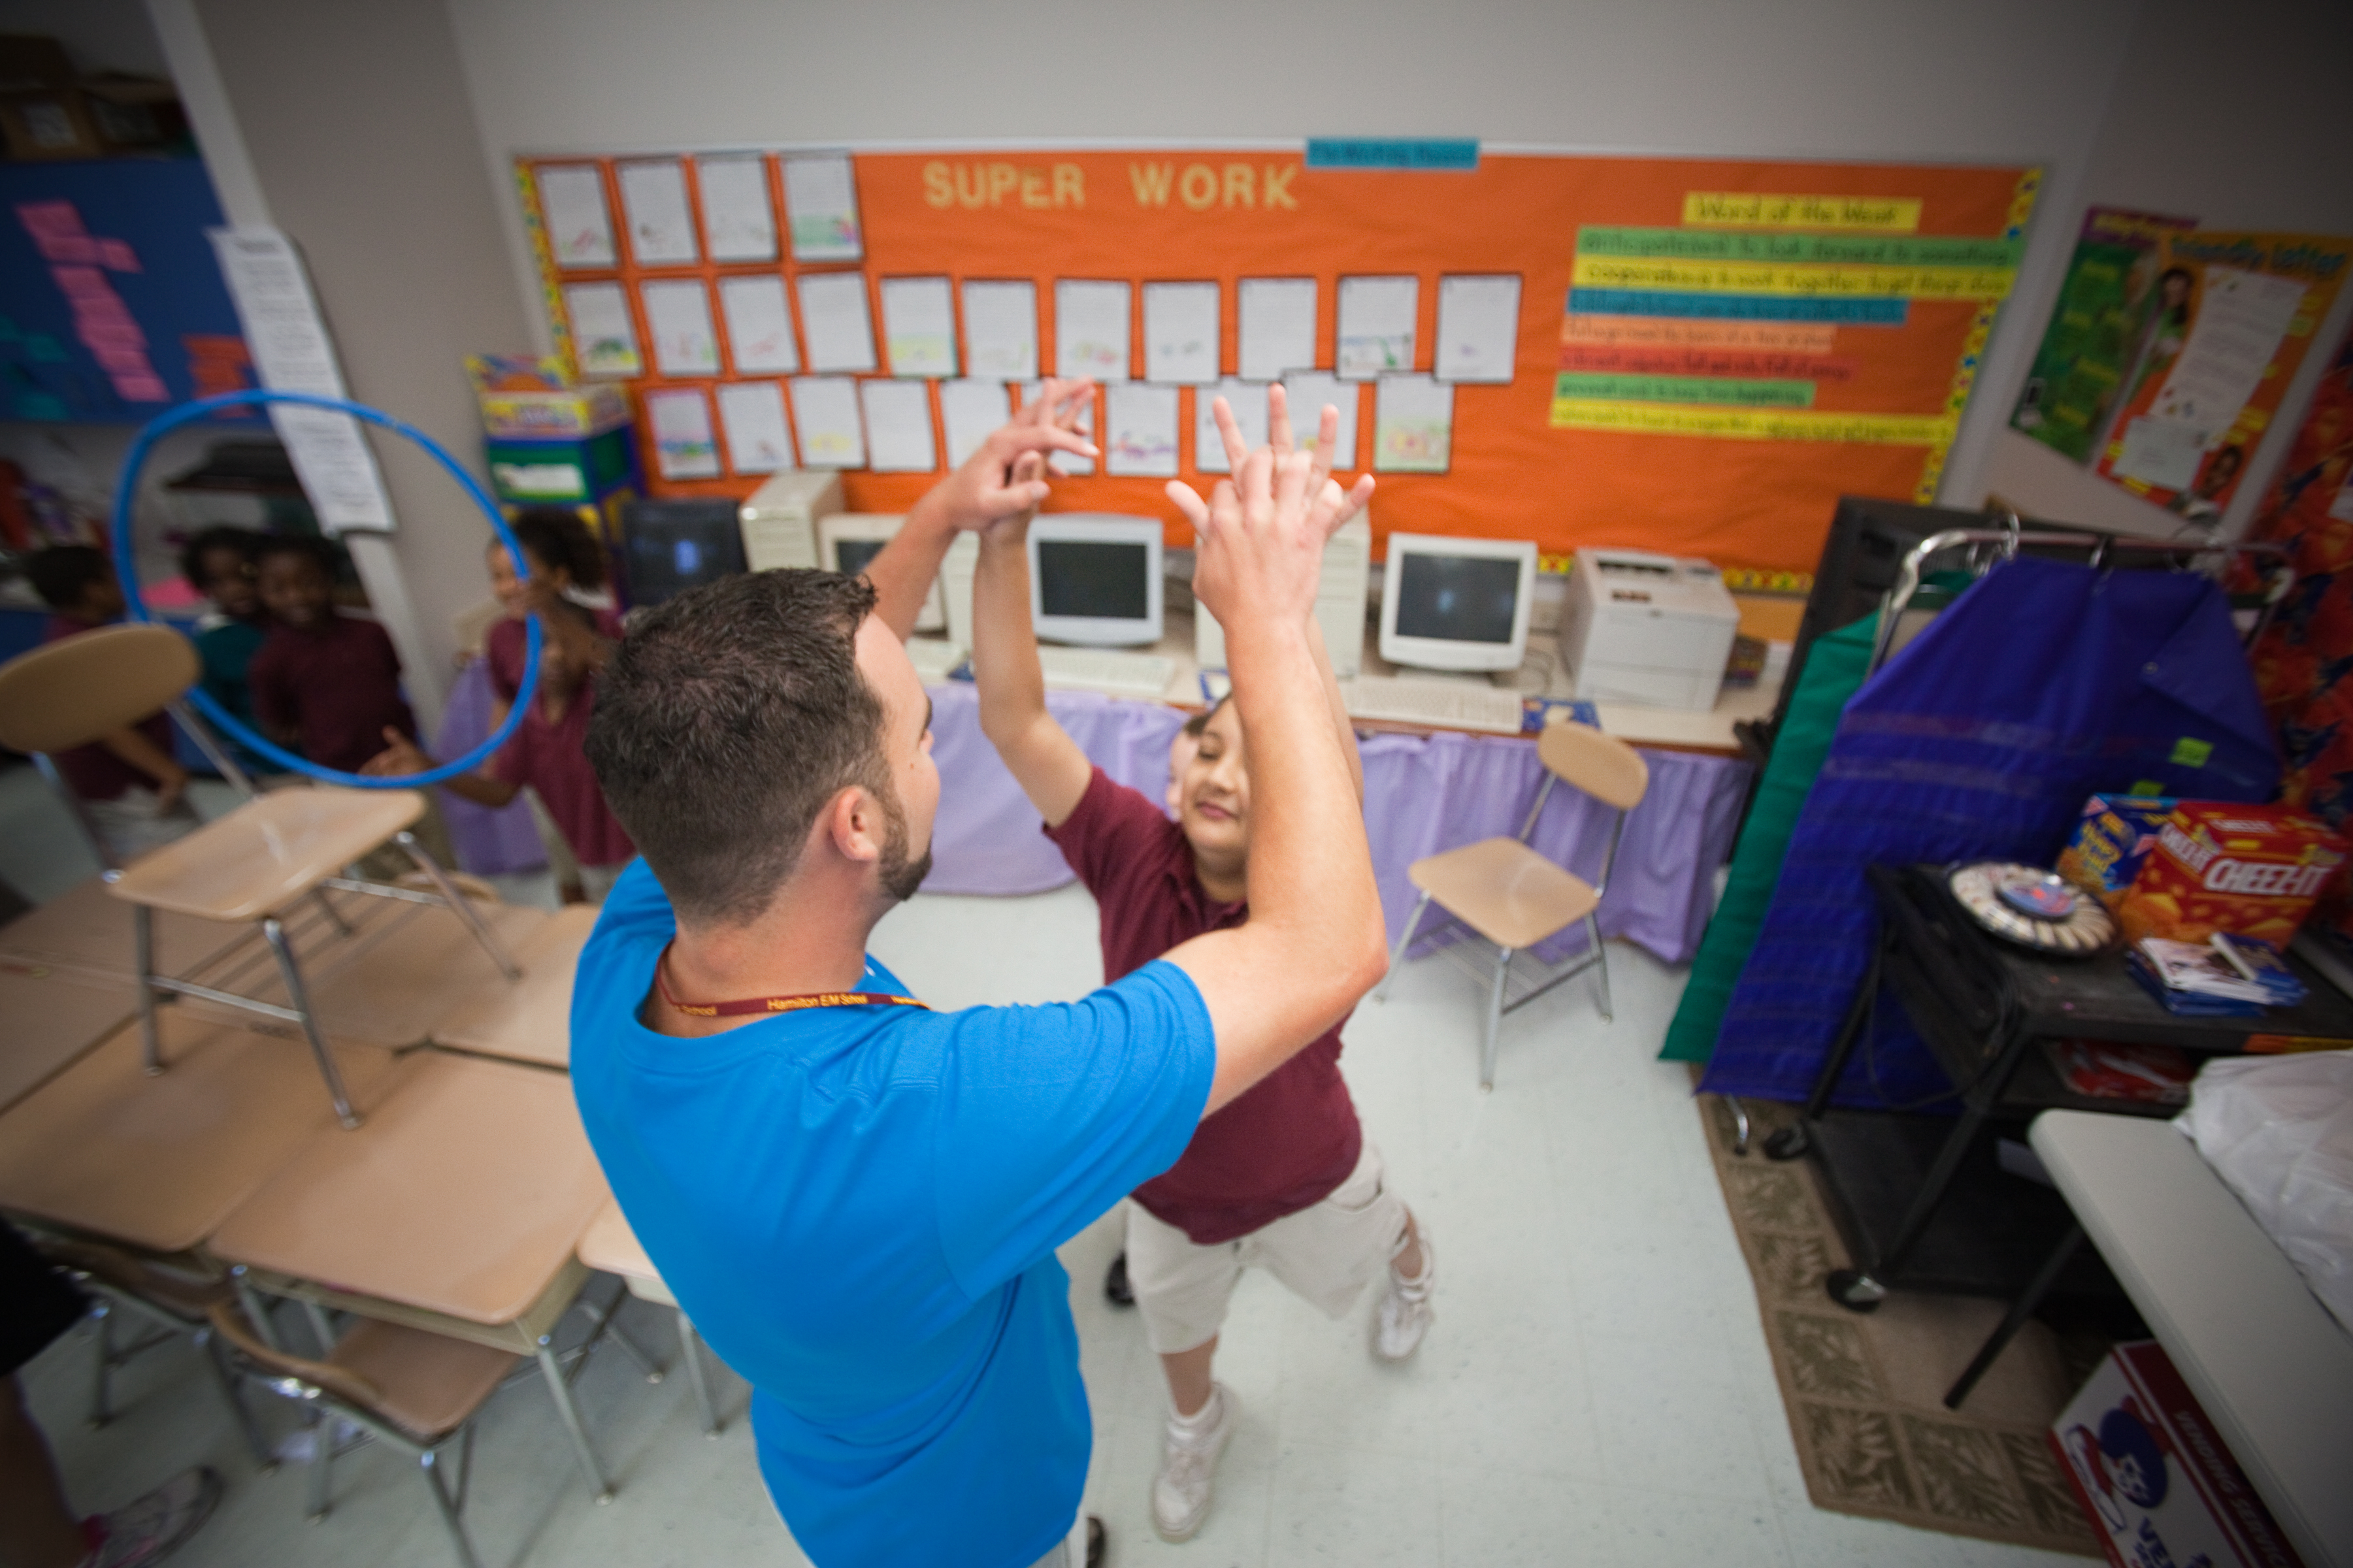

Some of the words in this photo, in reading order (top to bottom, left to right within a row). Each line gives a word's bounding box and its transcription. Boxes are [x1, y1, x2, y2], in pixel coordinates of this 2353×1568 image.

[922, 160, 1086, 210] SUPER
[1127, 161, 1299, 210] WORK
[2173, 1409, 2239, 1495] VENDING
